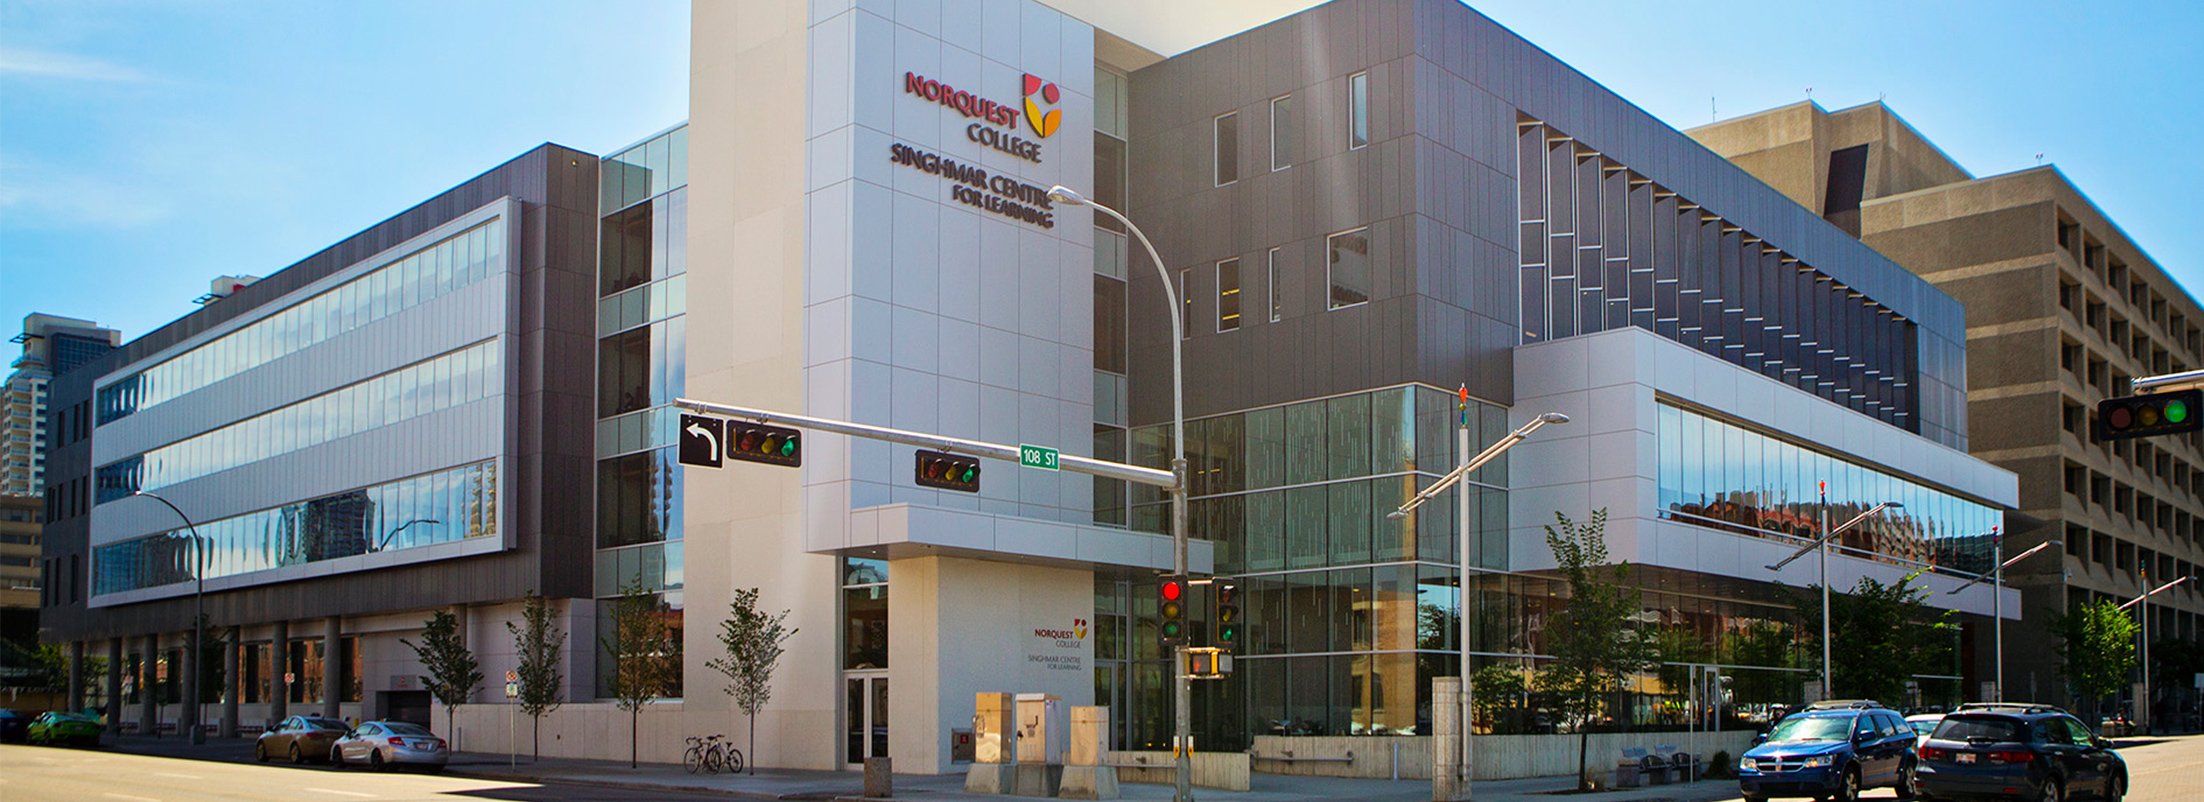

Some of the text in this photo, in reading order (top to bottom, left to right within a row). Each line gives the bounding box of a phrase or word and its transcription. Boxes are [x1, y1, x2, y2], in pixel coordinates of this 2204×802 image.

[905, 71, 1020, 129] NORQUEST
[967, 122, 1042, 163] COLLEGE
[890, 143, 988, 190] SINGHMAR
[952, 184, 1055, 229] FOR LEARNING
[1023, 449, 1056, 466] 108 ST
[1034, 628, 1073, 640] NORQUEST
[1056, 640, 1081, 649] COLLEGE
